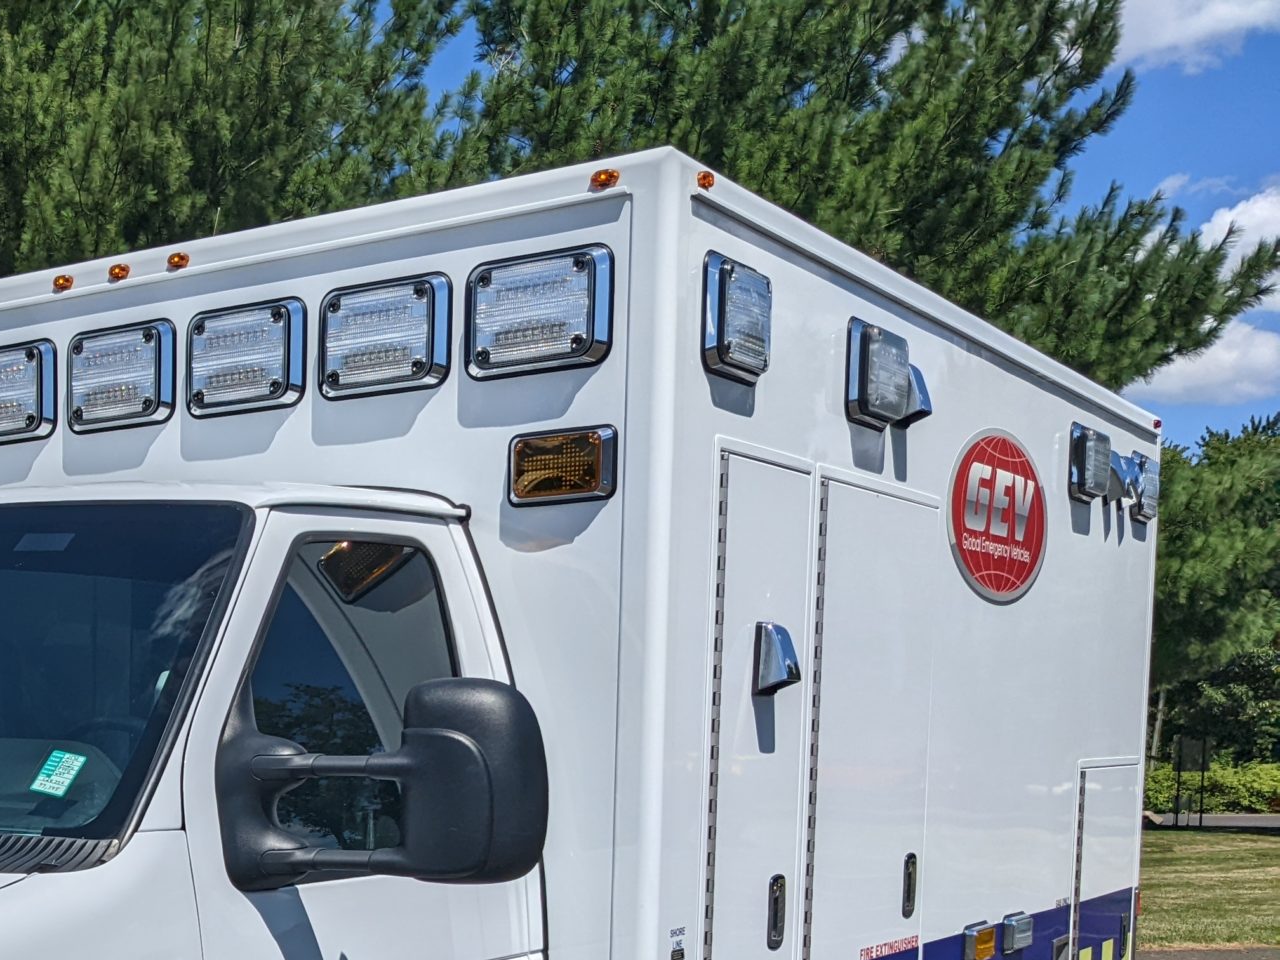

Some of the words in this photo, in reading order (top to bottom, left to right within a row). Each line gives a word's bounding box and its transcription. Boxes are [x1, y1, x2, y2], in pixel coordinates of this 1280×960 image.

[964, 461, 1035, 542] GEV
[962, 532, 981, 551] Global
[981, 536, 1010, 559] Emergency
[1010, 543, 1031, 563] Vehicles
[669, 926, 686, 938] SHORE
[672, 939, 684, 950] LINE
[875, 935, 919, 957] EXTINGUISHER
